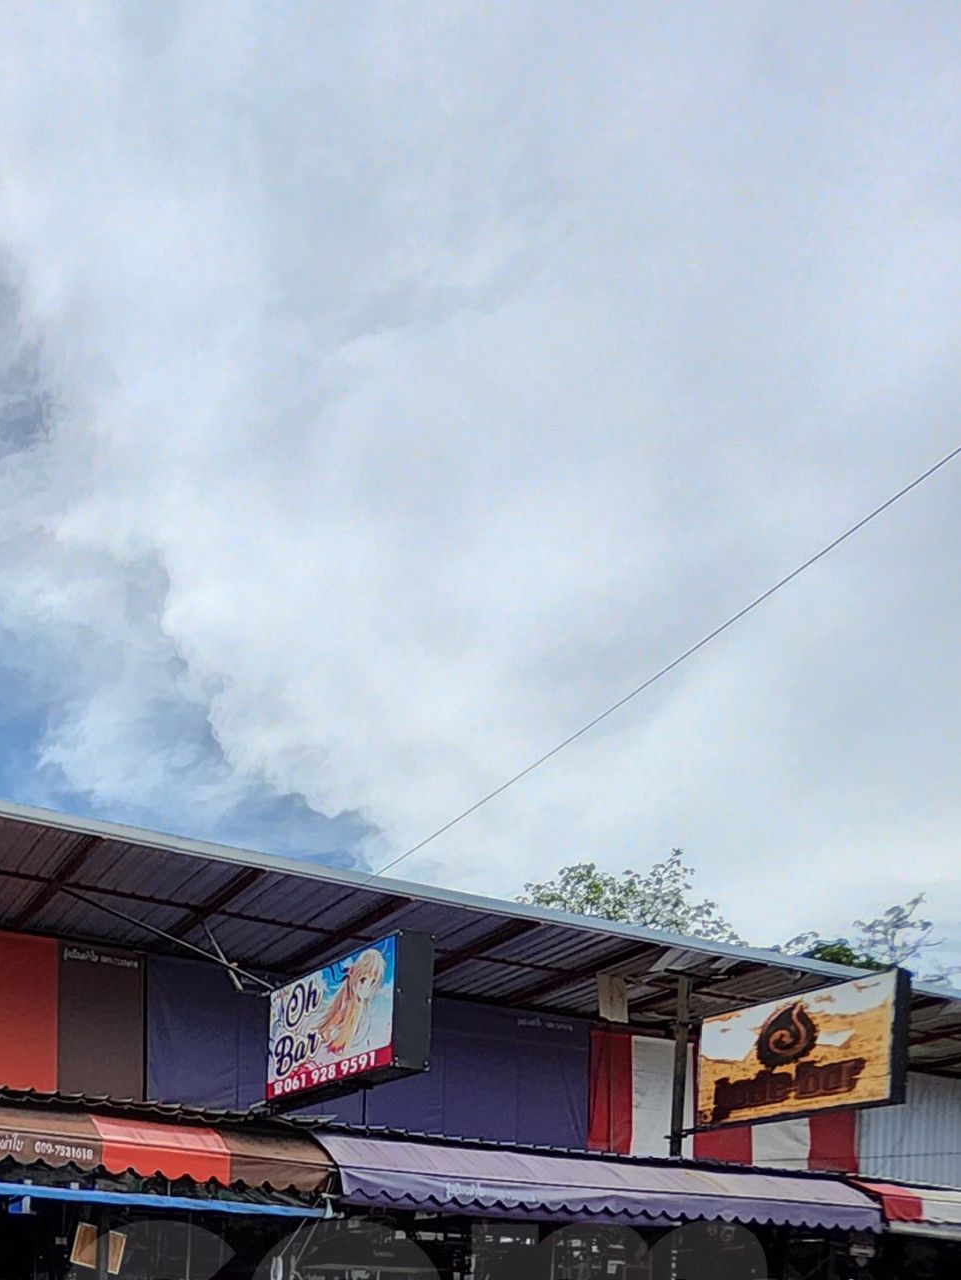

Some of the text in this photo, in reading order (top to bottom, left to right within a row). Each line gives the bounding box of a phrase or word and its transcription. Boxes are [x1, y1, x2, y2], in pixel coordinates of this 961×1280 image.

[285, 980, 319, 1028] Oh
[274, 1030, 318, 1076] Bar
[284, 1052, 376, 1093] 061 928 9591
